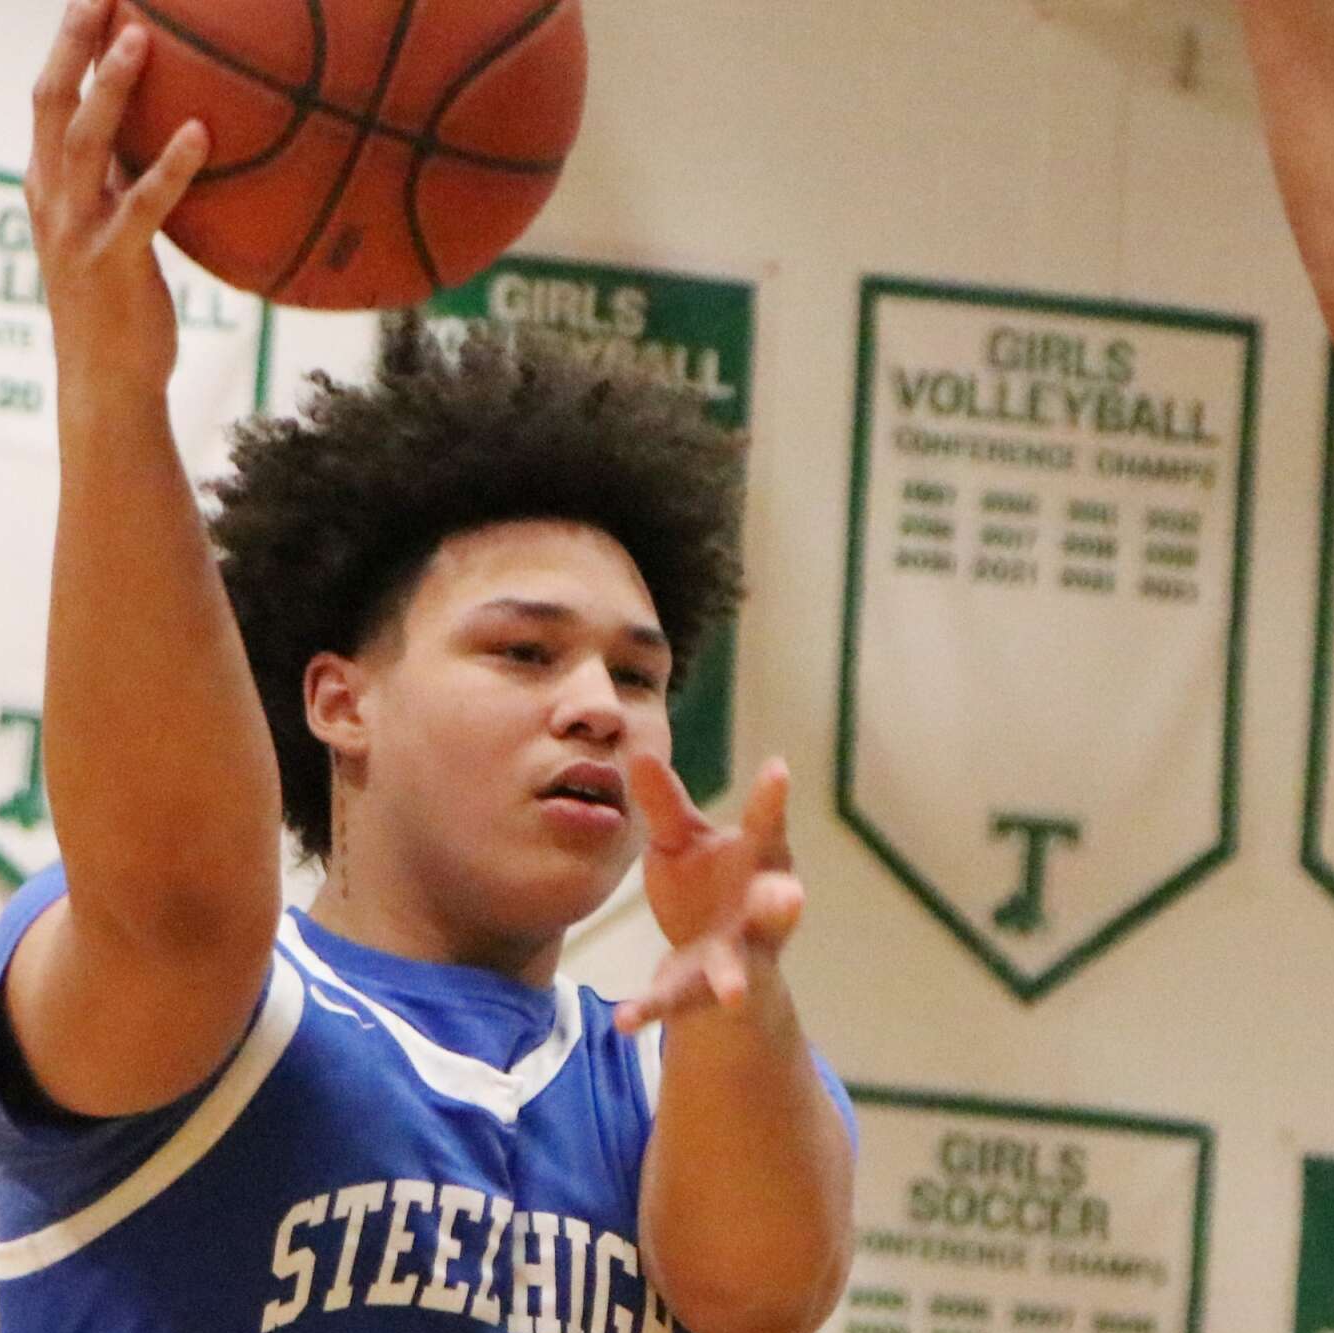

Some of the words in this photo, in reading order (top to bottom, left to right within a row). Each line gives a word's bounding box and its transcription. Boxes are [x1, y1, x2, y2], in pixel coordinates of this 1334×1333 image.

[986, 326, 1136, 386] GIRLS
[892, 367, 1220, 449] VOLLEYBALL
[989, 811, 1082, 934] T
[939, 1131, 1088, 1193] GIRLS
[909, 1177, 1110, 1241] SOCCER
